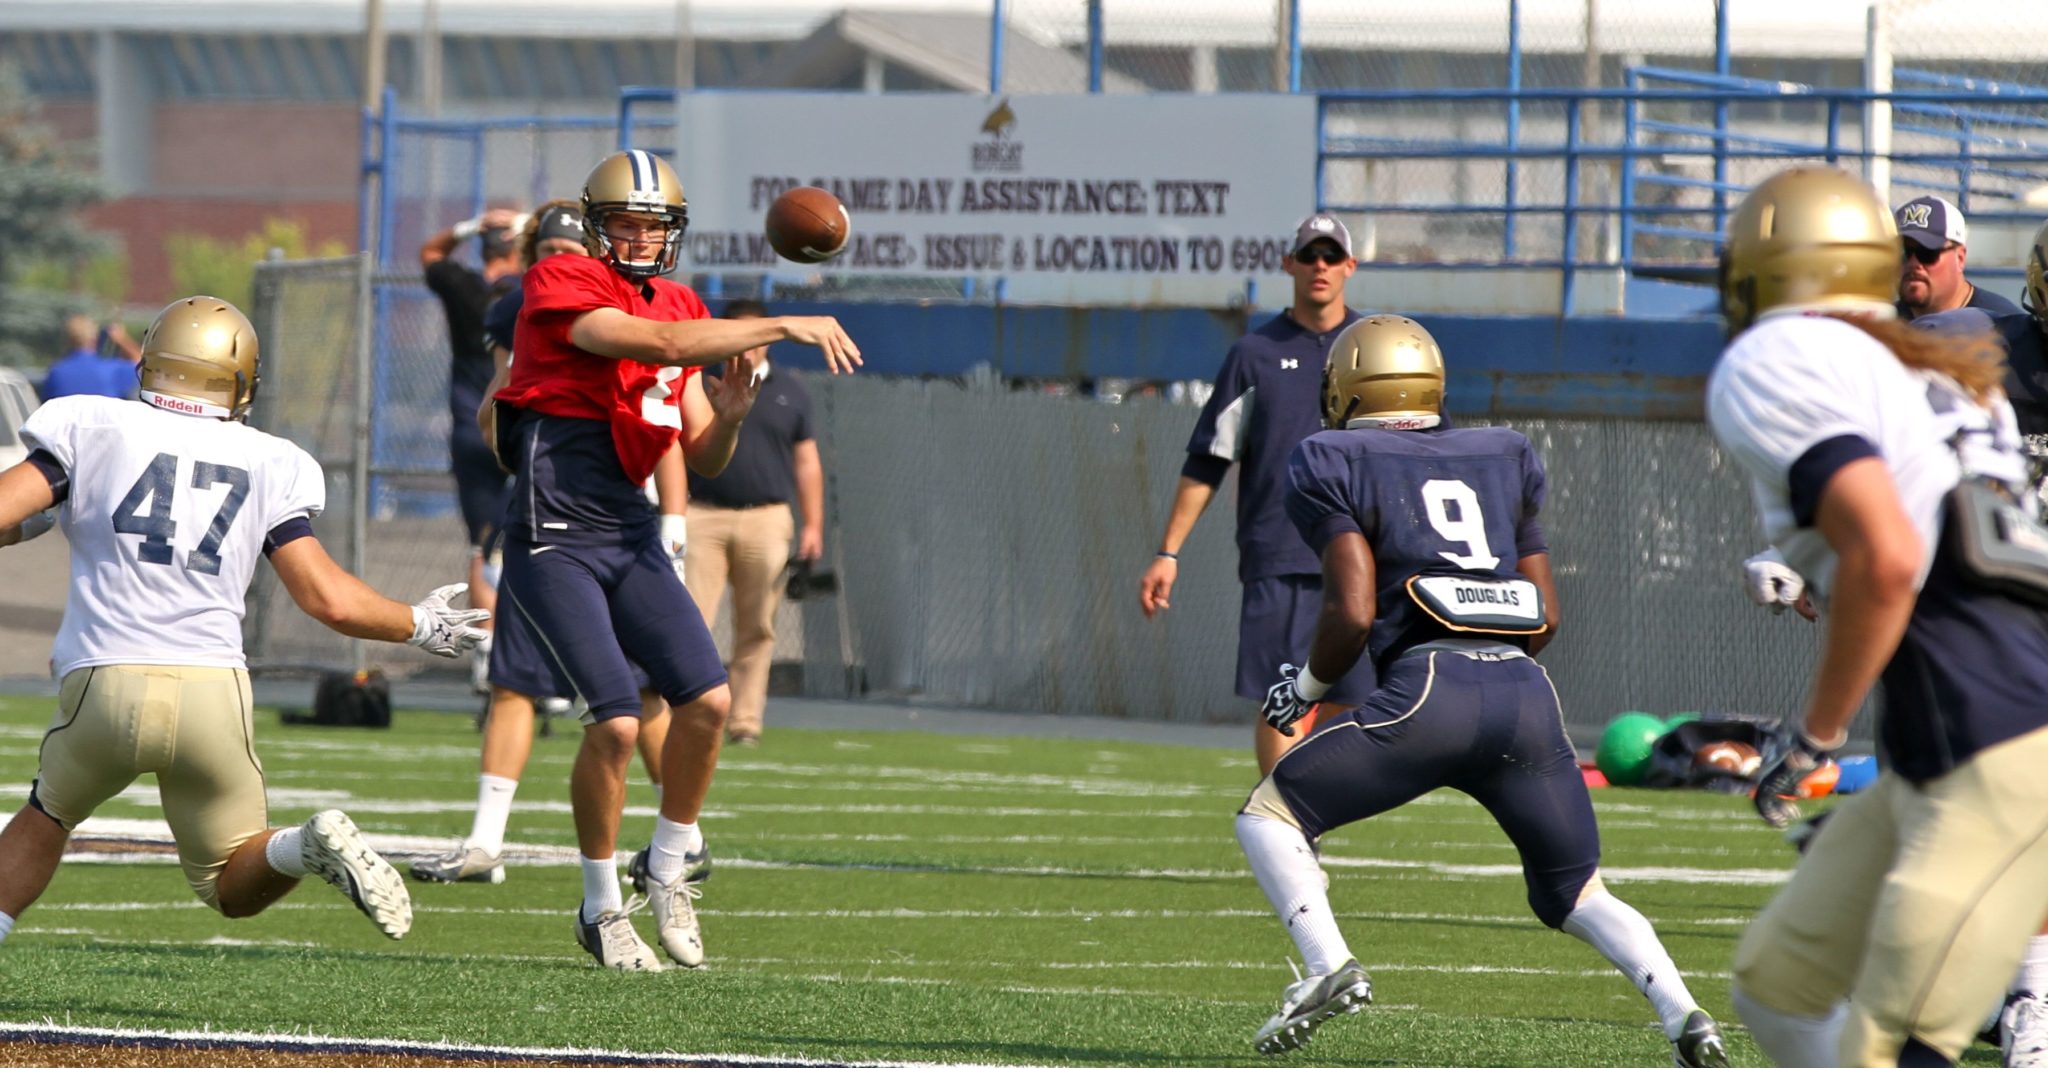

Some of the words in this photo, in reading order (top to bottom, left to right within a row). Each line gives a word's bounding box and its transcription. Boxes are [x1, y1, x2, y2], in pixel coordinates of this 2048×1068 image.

[751, 175, 800, 210] FO
[809, 176, 891, 212] AME
[898, 177, 953, 214] DAY
[960, 177, 1148, 215] ASSISTANCE:
[1155, 180, 1231, 216] TEXT
[925, 234, 1004, 270] ISSUE
[1011, 236, 1027, 270] &
[1034, 235, 1180, 271] LOCATION
[1187, 238, 1224, 271] TO
[154, 395, 203, 414] Riddell
[111, 452, 251, 577] 47
[1421, 479, 1501, 570] 9
[1455, 587, 1521, 606] DOUGLAS
